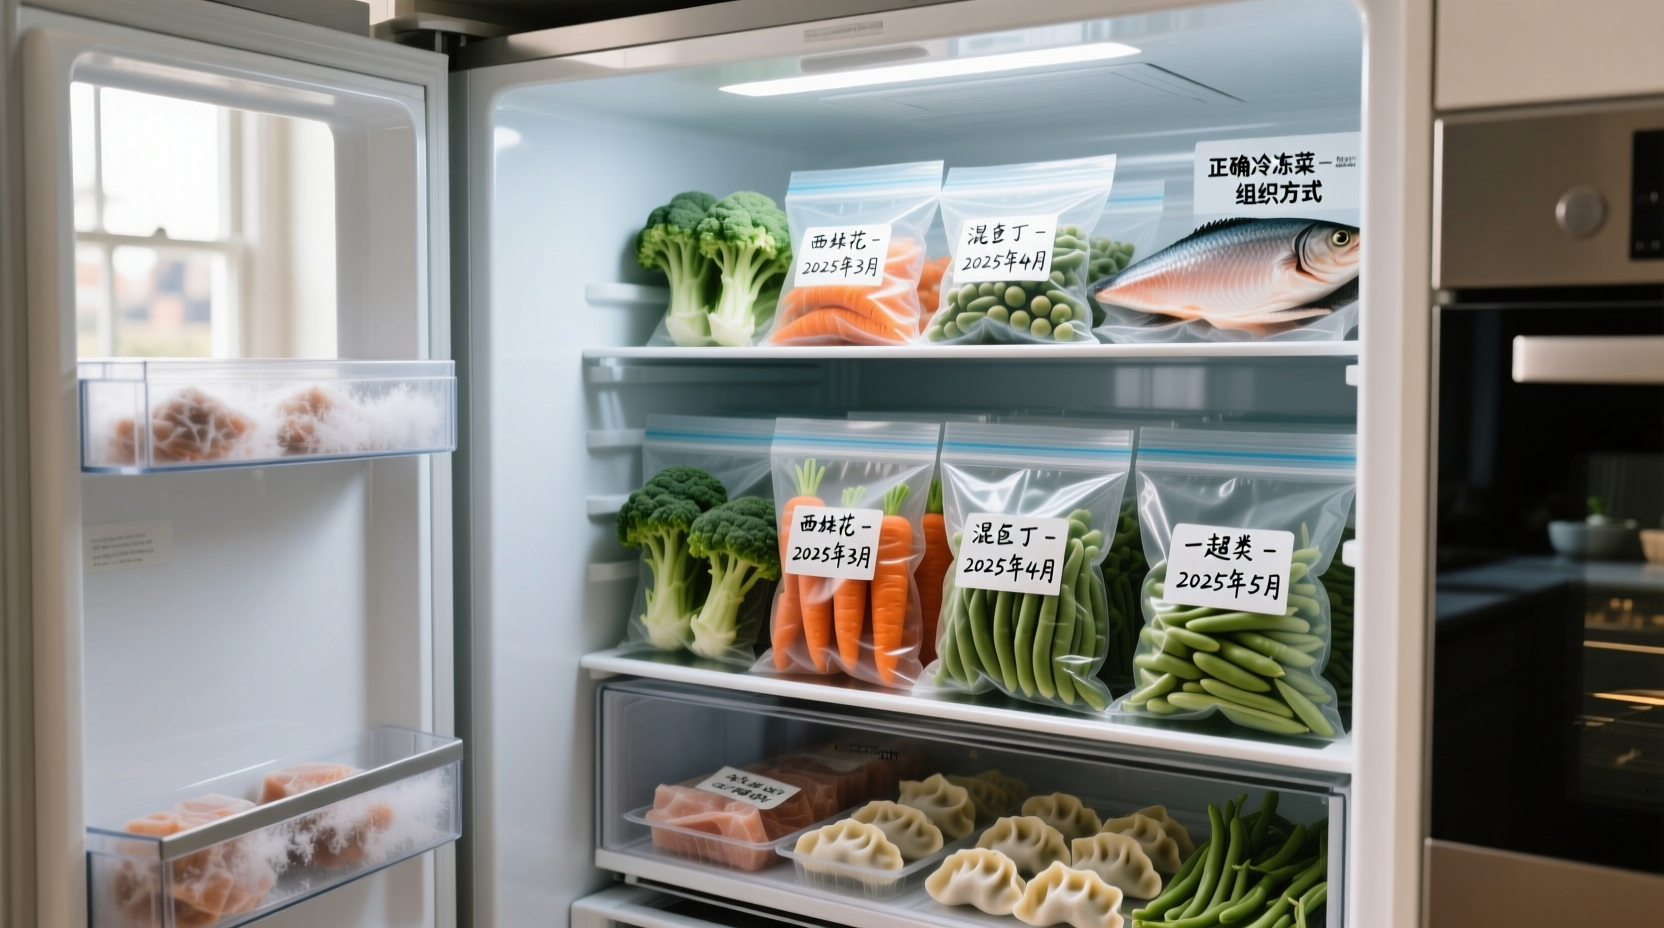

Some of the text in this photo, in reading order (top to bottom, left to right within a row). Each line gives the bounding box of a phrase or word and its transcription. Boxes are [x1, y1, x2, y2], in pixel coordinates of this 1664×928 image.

[1235, 179, 1323, 205] 组织方式
[802, 256, 878, 278] 2025年3月
[961, 249, 1046, 273] 2025年4月
[791, 541, 871, 569] 2025年3月
[963, 553, 1055, 584] 2025年4月
[1175, 568, 1281, 601] 2025年5月
